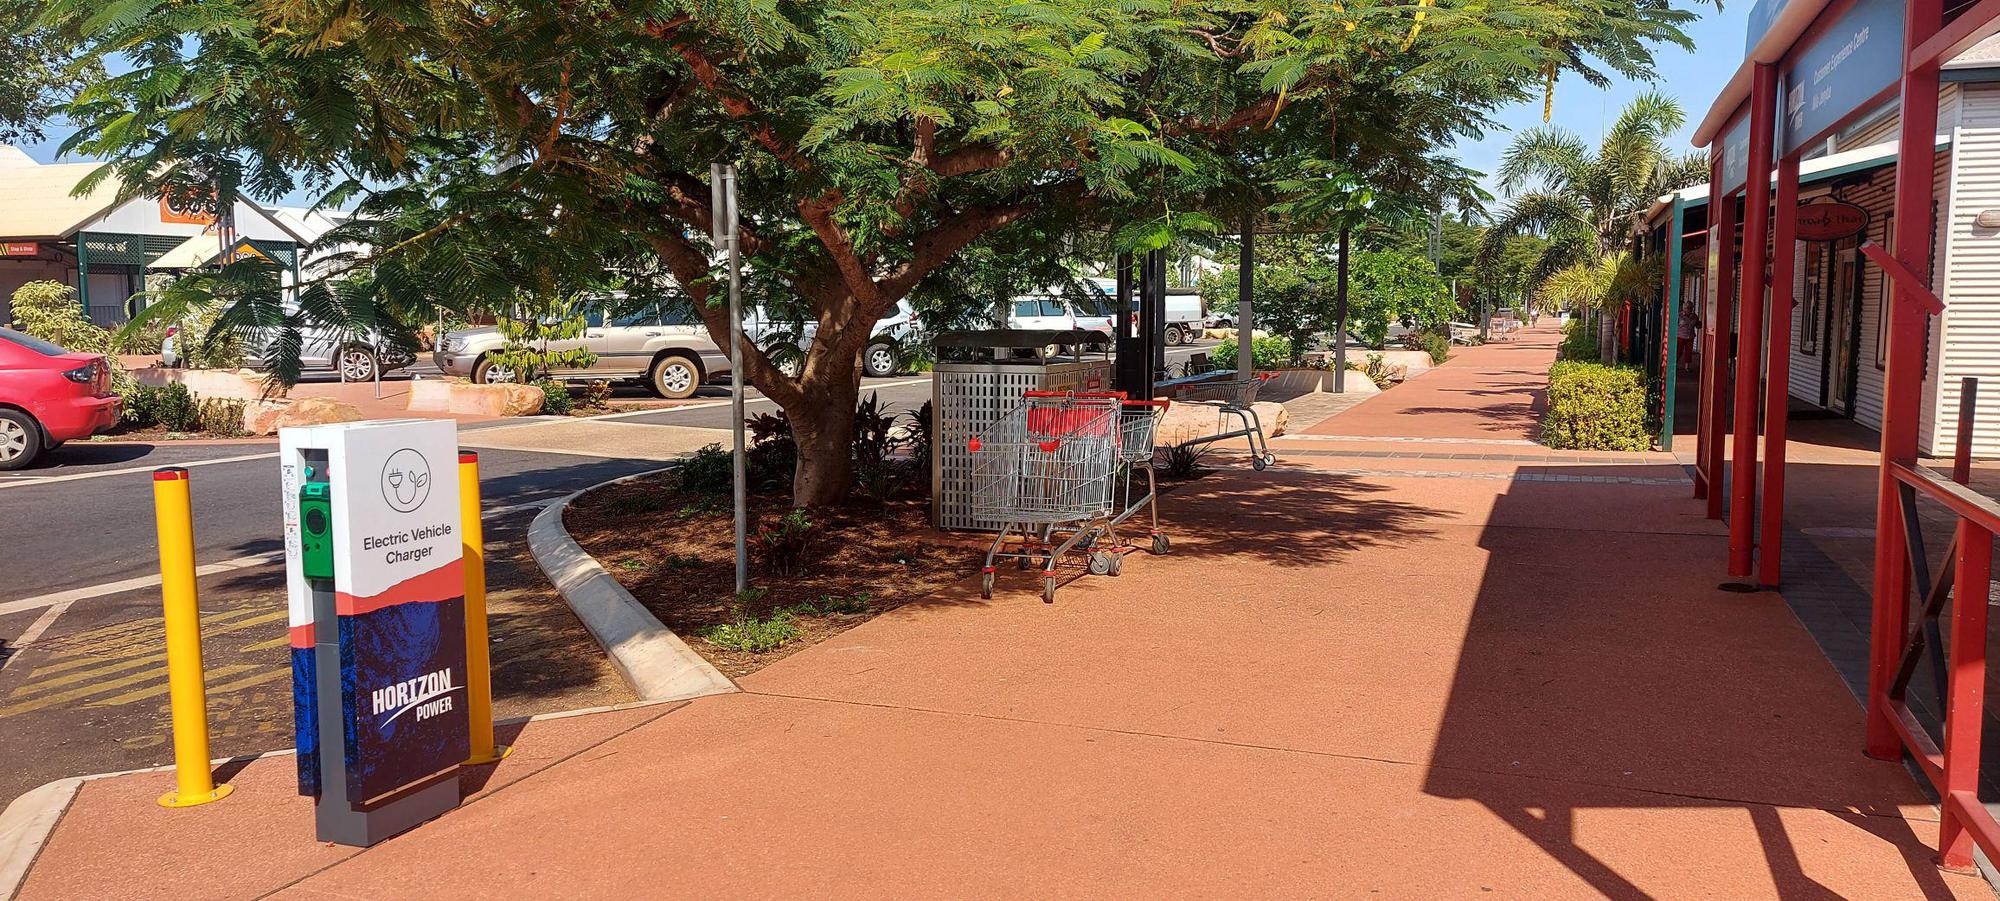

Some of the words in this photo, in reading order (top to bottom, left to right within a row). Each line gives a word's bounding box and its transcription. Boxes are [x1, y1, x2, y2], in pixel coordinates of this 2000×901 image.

[364, 532, 409, 551] Electric
[411, 523, 452, 541] Vehicle
[386, 546, 433, 564] Charger
[372, 667, 451, 715] HORIZON
[416, 696, 453, 722] POWER
